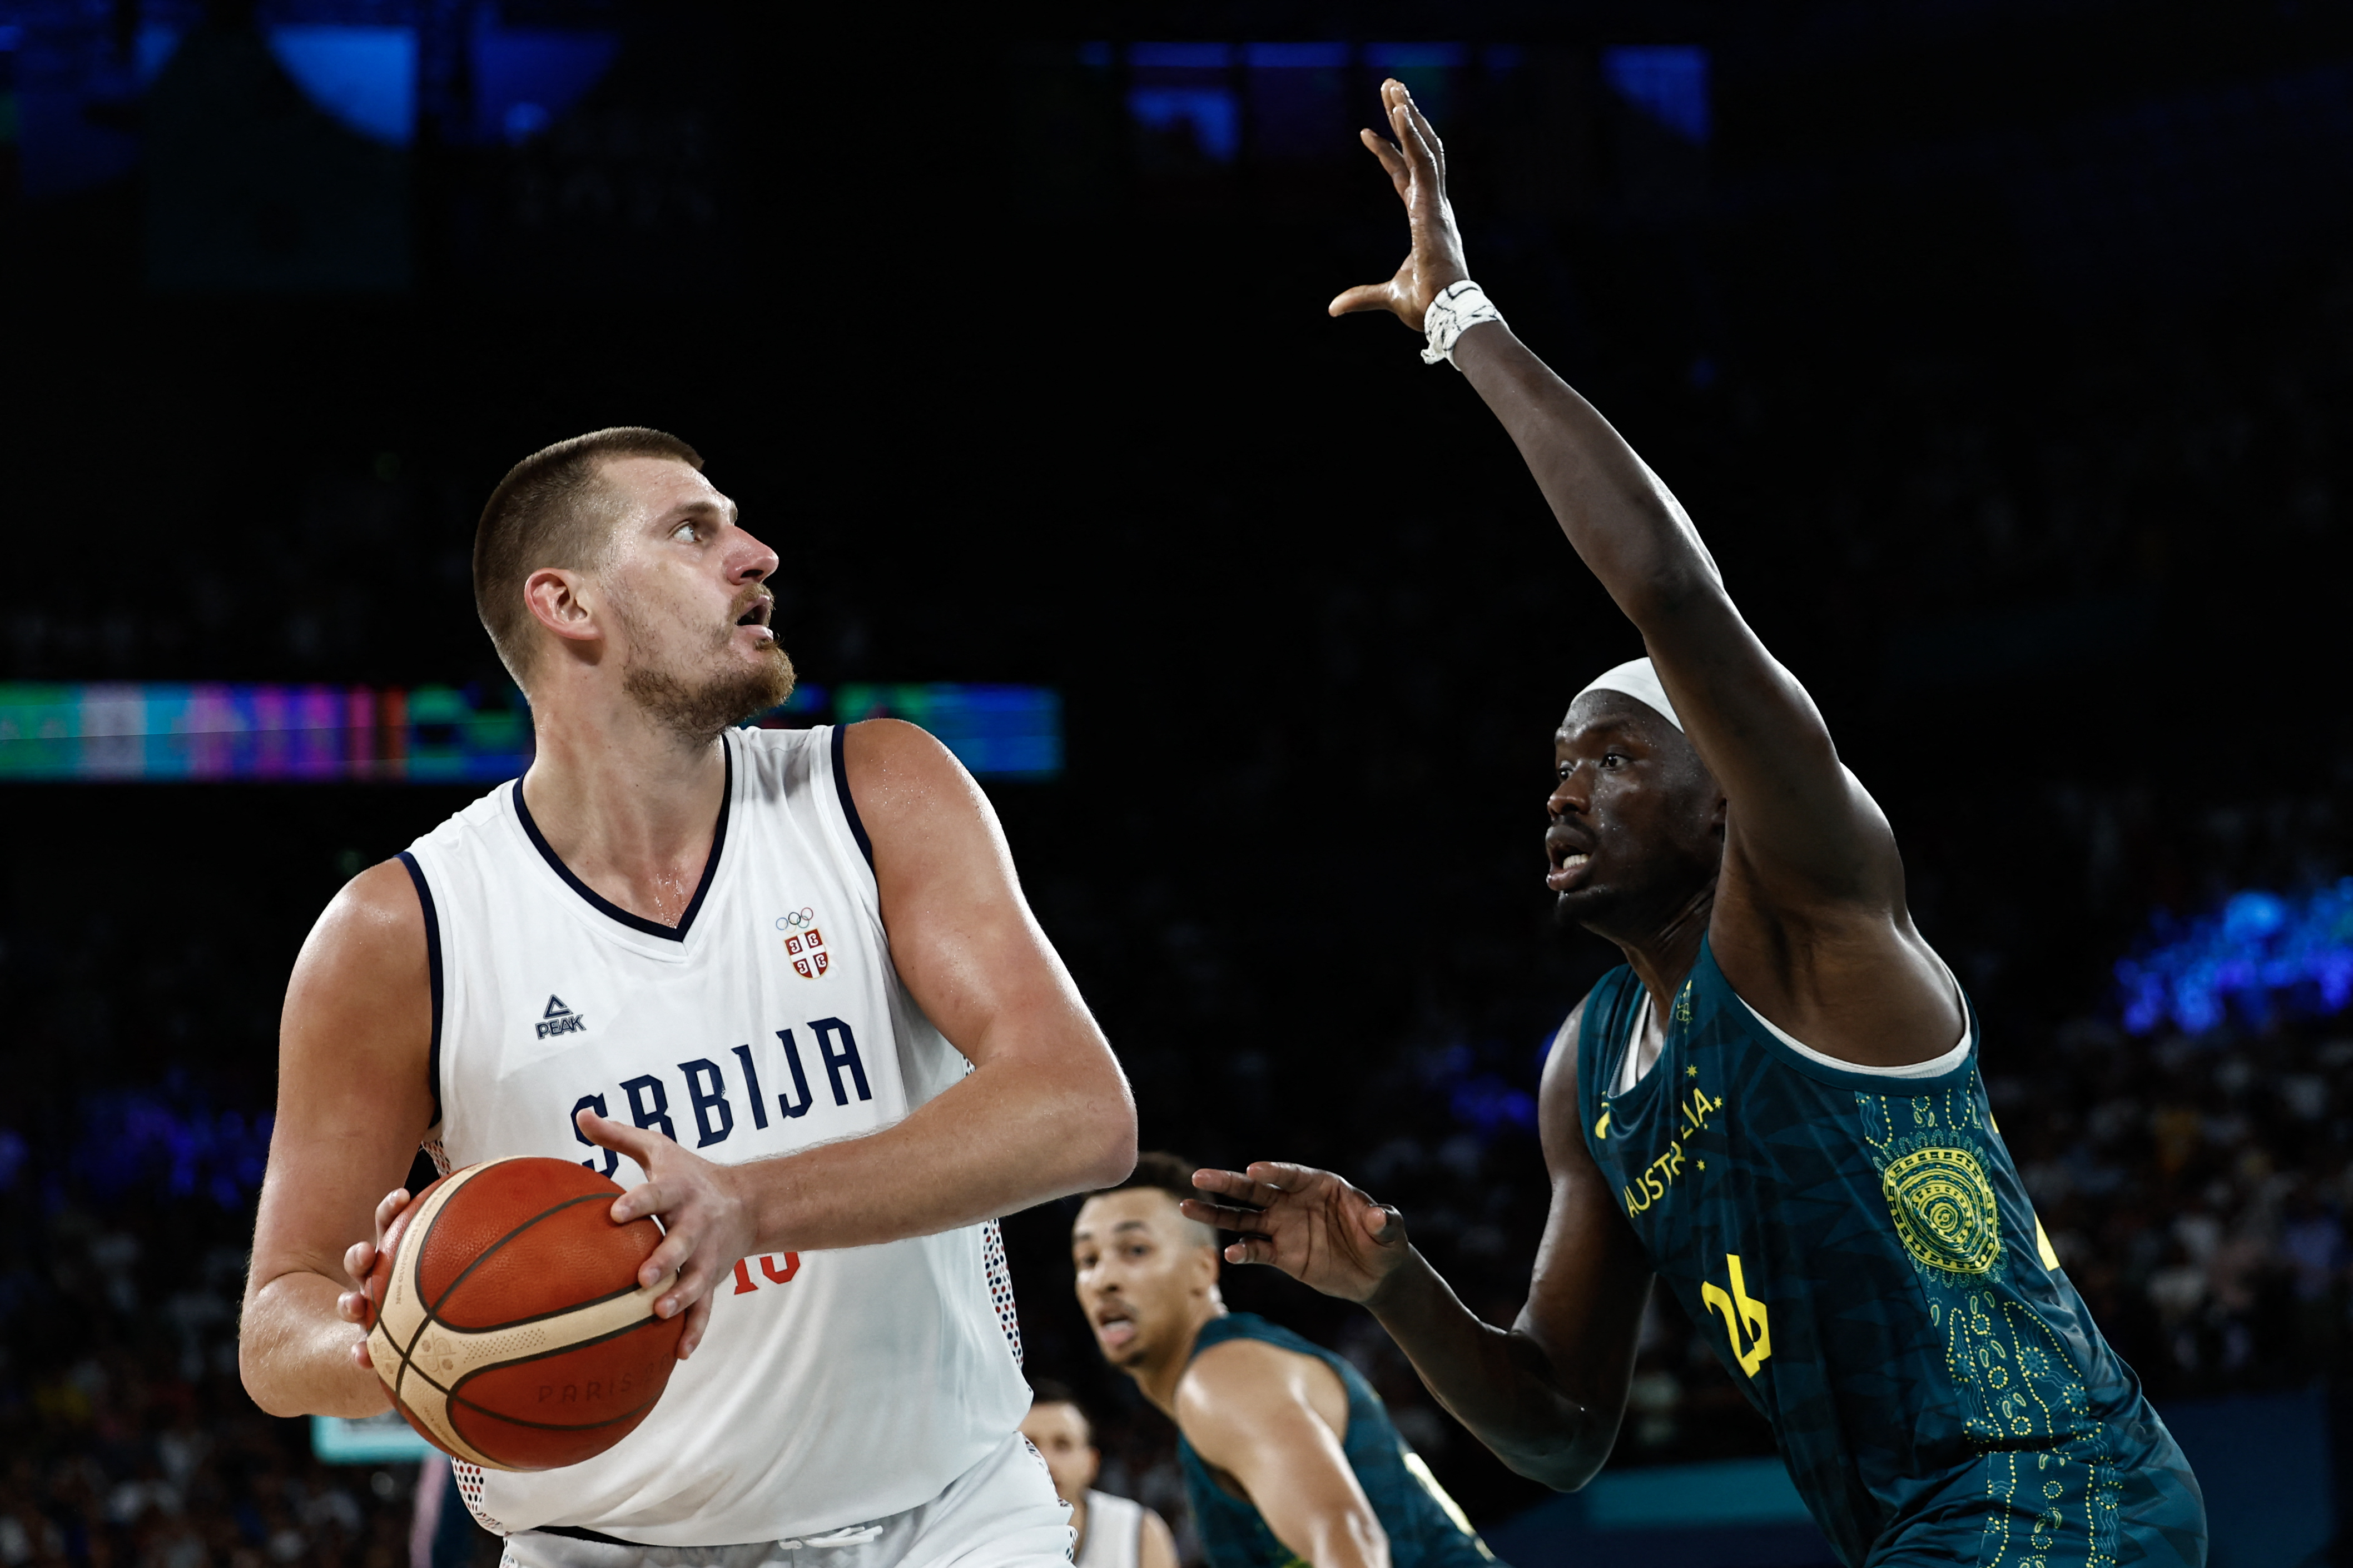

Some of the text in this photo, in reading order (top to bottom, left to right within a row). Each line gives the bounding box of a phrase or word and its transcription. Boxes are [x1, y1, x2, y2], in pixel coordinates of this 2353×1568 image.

[535, 1014, 586, 1039] PEAK
[570, 1017, 872, 1179] SRBIJA
[1623, 1088, 1714, 1218] AUSTRLIA
[1701, 1253, 1771, 1378] 26
[538, 1373, 632, 1403] PARIS
